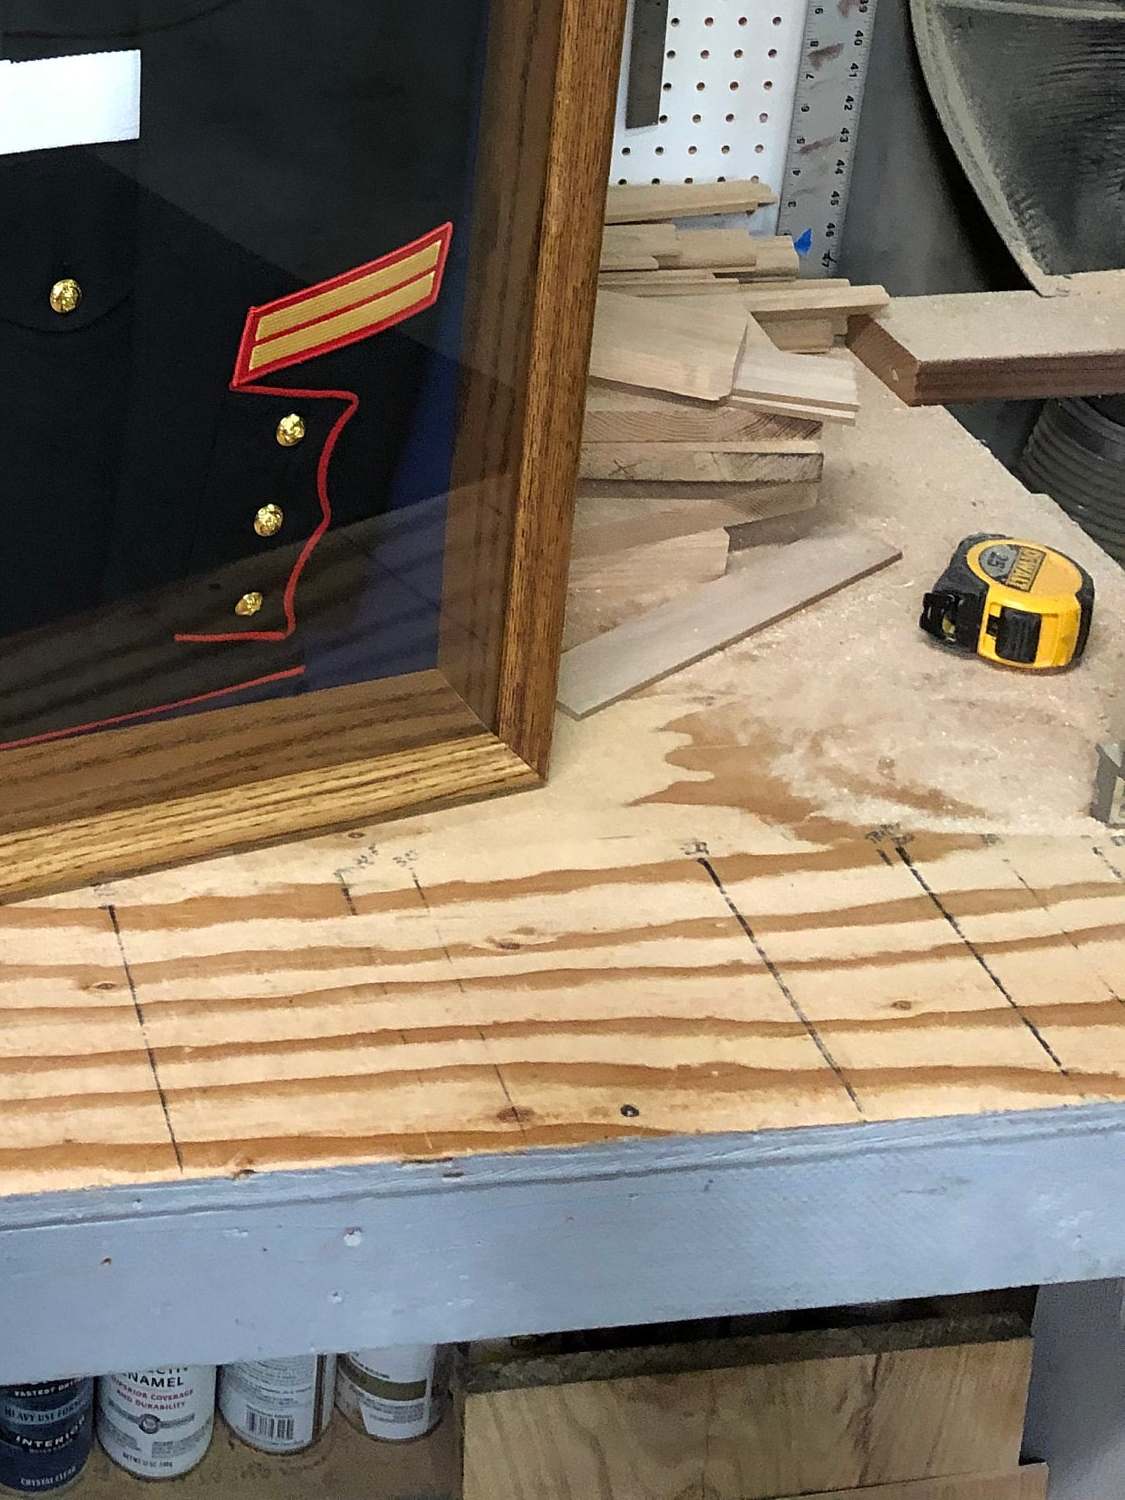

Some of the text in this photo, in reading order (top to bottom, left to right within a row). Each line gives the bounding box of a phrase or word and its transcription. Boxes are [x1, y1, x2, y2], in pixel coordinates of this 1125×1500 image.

[809, 40, 820, 48] 8
[853, 30, 864, 46] 40
[849, 63, 860, 78] 41
[14, 1386, 56, 1397] FASTEST
[150, 1388, 194, 1401] COVERAGE
[116, 1388, 186, 1411] AND DURABILITY
